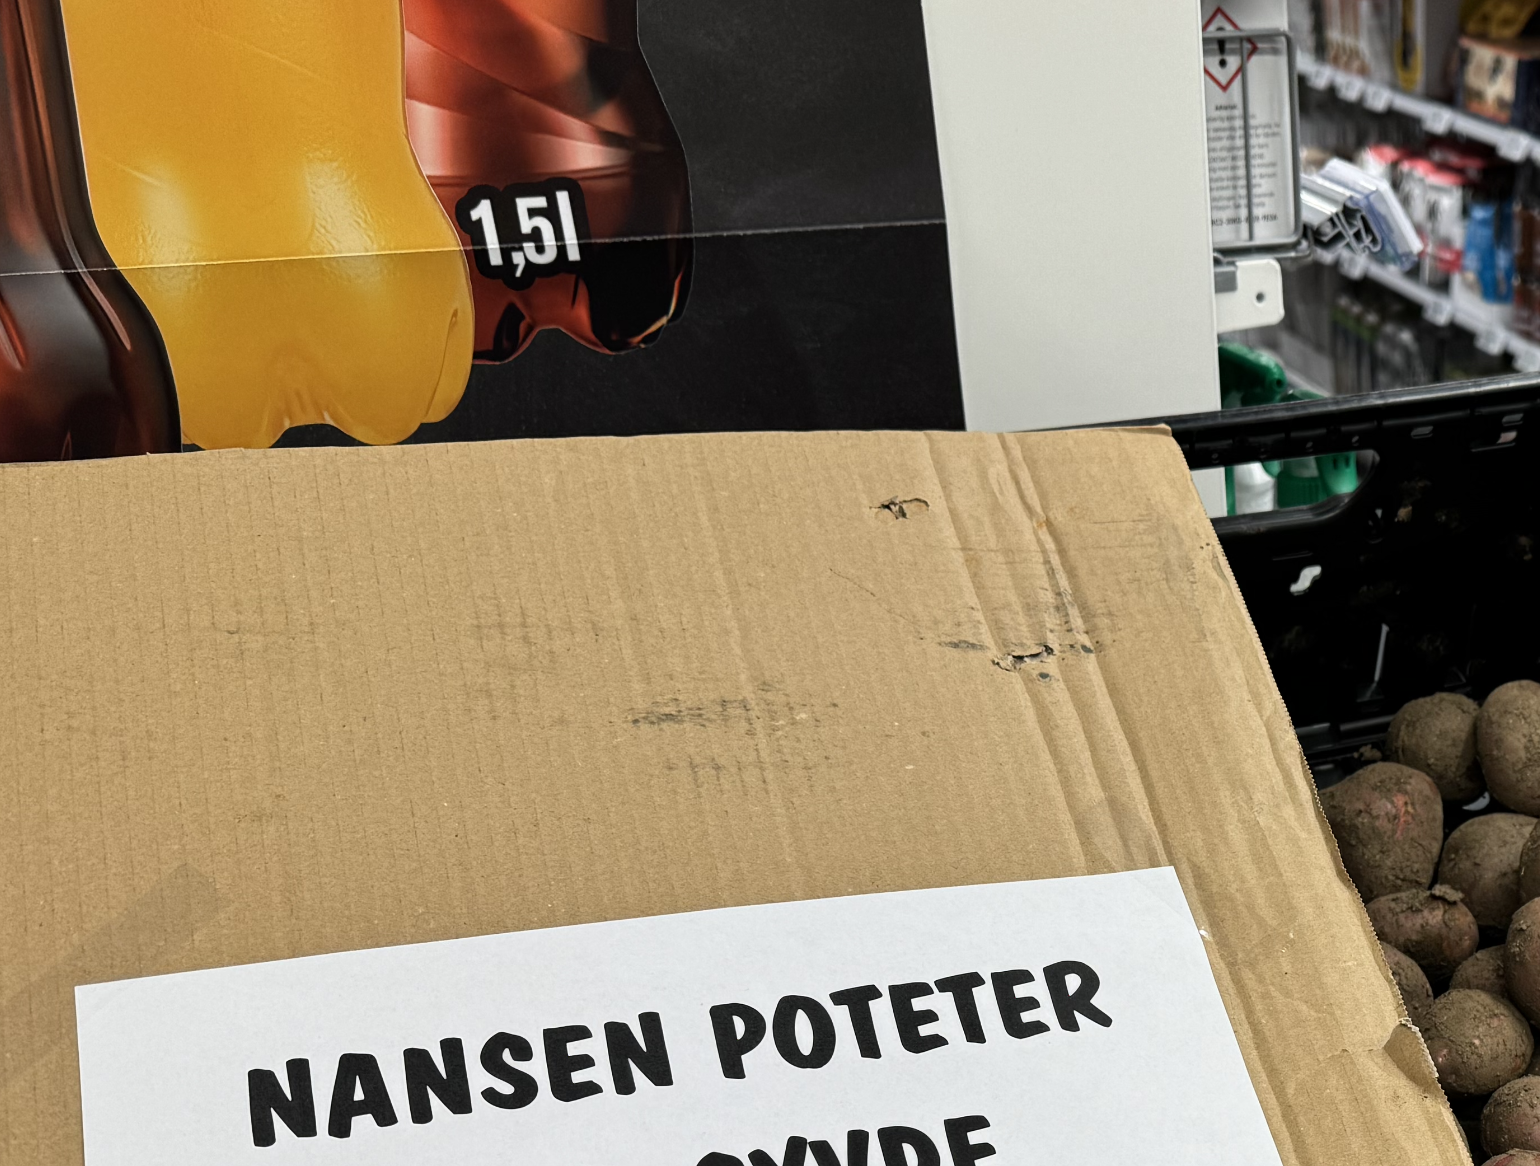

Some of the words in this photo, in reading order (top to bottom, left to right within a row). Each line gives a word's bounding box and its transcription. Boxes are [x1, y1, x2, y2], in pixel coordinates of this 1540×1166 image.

[469, 189, 581, 278] 1,5l
[248, 1011, 673, 1147] NANSEN
[709, 960, 1113, 1080] POTETER
